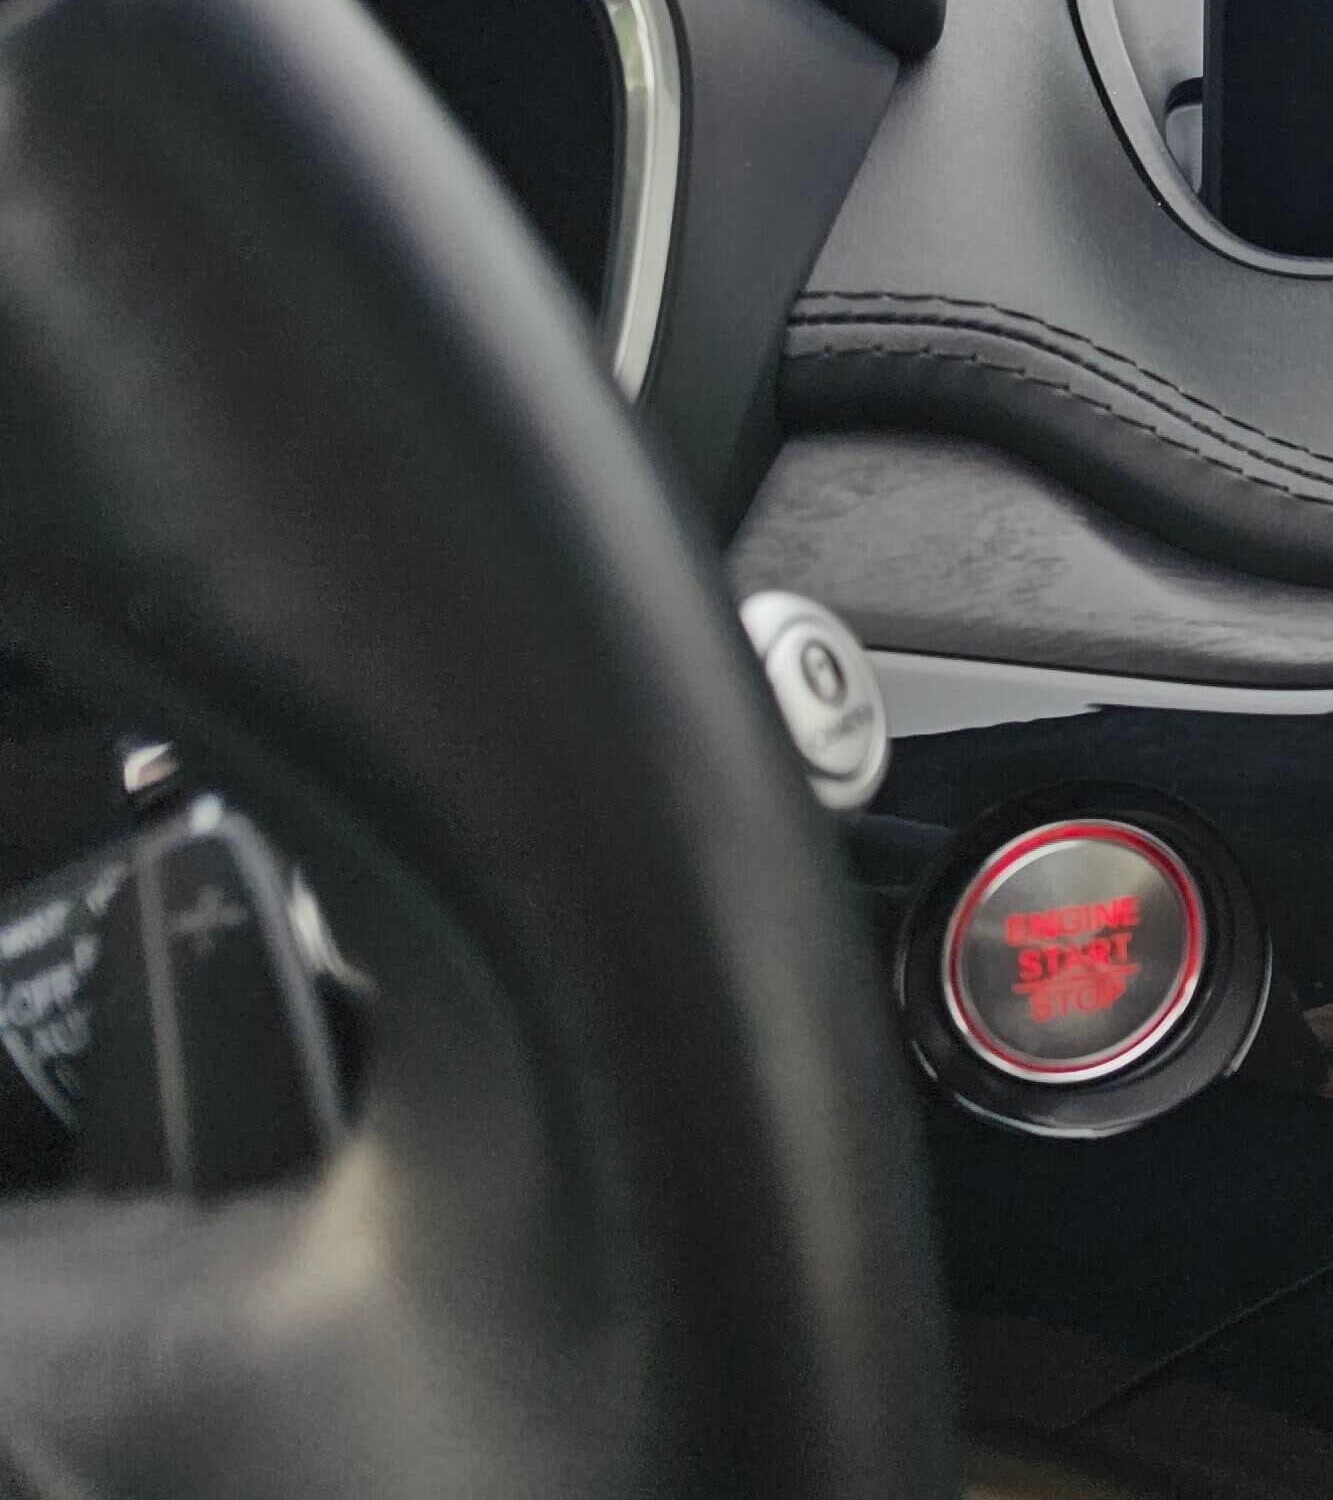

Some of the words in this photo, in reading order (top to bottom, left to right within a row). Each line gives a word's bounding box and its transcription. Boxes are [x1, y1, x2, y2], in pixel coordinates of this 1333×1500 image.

[1005, 894, 1140, 946] ENGINE
[1019, 932, 1133, 981] START
[1030, 973, 1126, 1023] STOP
